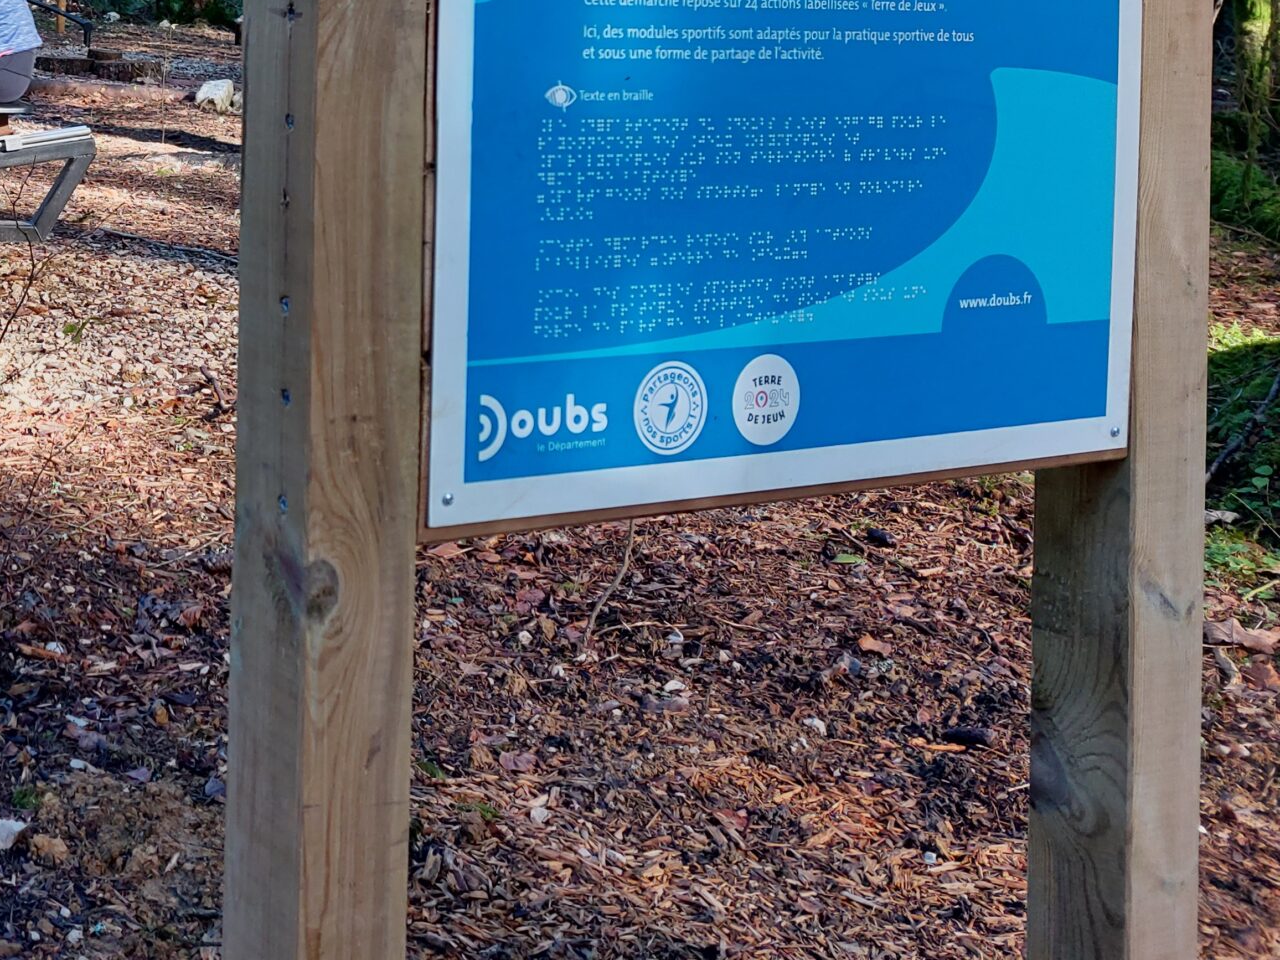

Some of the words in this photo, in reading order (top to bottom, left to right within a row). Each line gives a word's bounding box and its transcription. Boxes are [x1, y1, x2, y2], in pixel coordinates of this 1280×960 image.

[582, 23, 601, 40] Ici,
[601, 23, 625, 39] des
[626, 24, 679, 39] modules
[680, 25, 726, 43] sportifs
[727, 27, 754, 40] sont
[755, 26, 802, 44] adaptés
[803, 30, 831, 44] pour
[832, 26, 843, 41] la
[843, 27, 891, 45] pratique
[891, 28, 935, 45] sportive
[936, 27, 950, 42] de
[950, 29, 975, 43] tous
[581, 45, 596, 60] et
[597, 47, 627, 60] sous
[628, 48, 653, 60] une
[654, 44, 692, 60] forme
[693, 45, 709, 60] de
[710, 47, 756, 64] partage
[757, 45, 772, 60] de
[773, 45, 825, 60] l'activité.
[578, 89, 606, 102] Texte
[606, 91, 621, 101] en
[621, 88, 654, 101] braille
[958, 290, 1033, 309] www.doubs.fr
[642, 371, 699, 403] Partageons
[752, 375, 782, 388] TERRE
[744, 389, 790, 410] 2024
[747, 412, 759, 425] DE
[643, 418, 657, 439] nos
[659, 422, 693, 446] sports
[537, 443, 546, 452] le
[548, 438, 606, 452] Département
